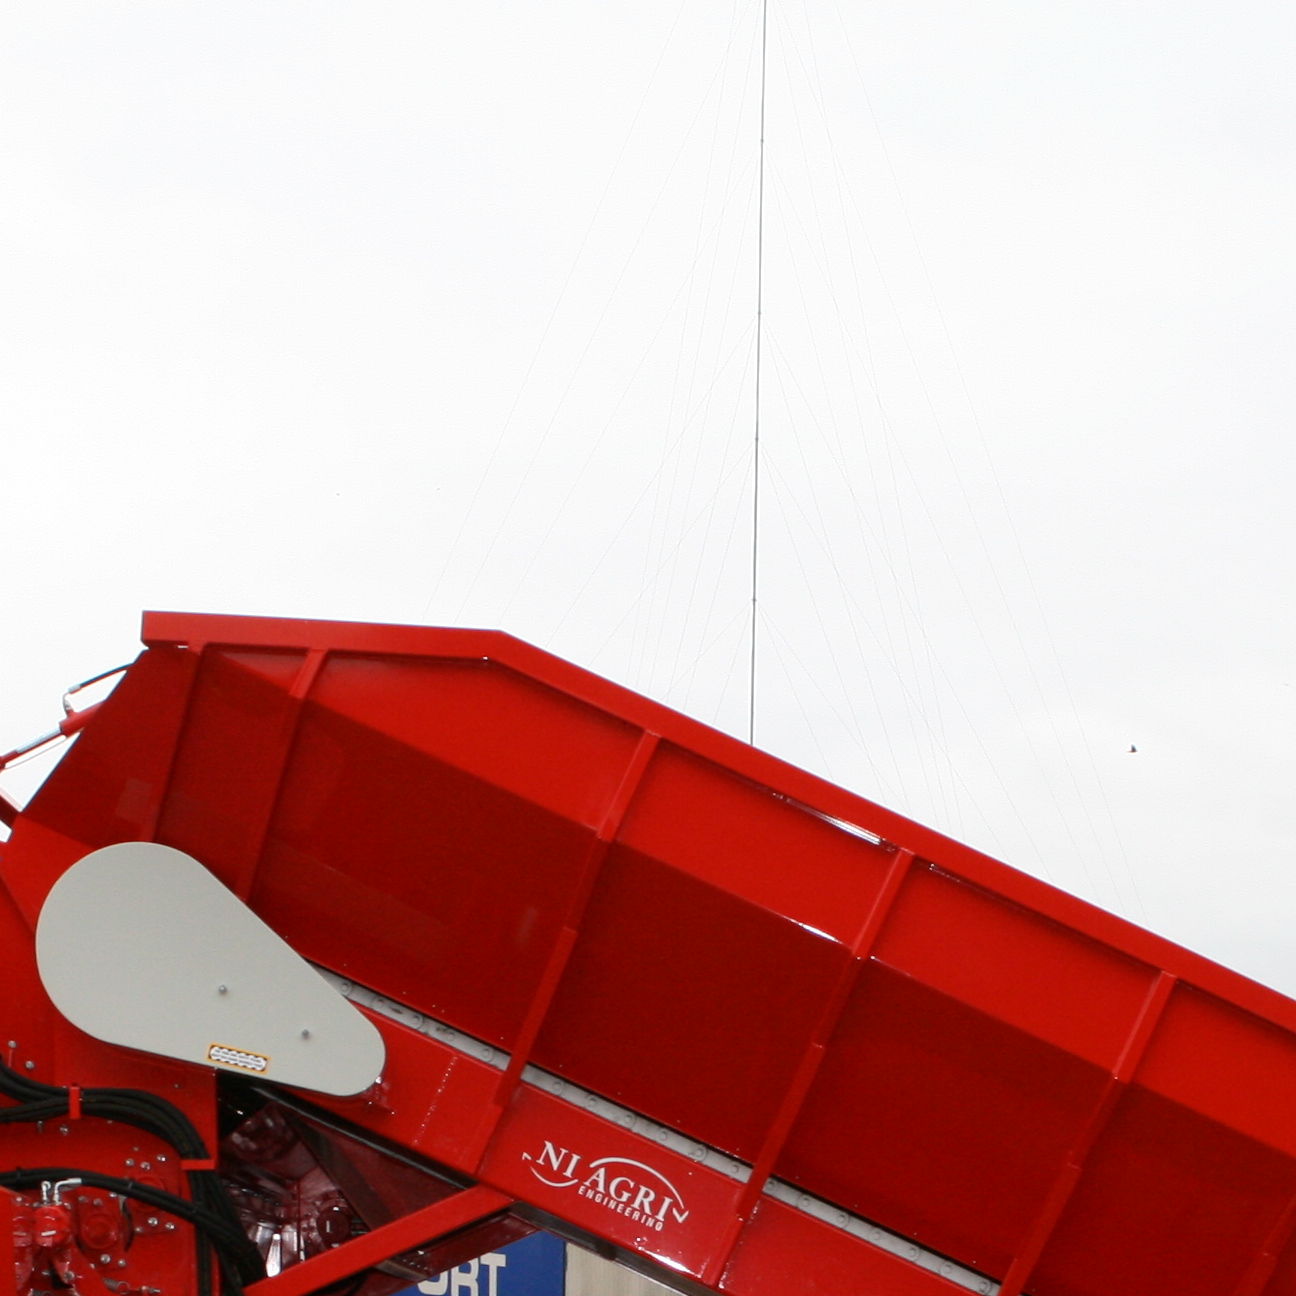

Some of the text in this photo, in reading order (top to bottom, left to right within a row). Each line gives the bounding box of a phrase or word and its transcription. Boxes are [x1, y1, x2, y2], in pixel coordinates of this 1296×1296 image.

[535, 1140, 673, 1223] NI AGRI
[577, 1184, 665, 1232] ENGINEERING
